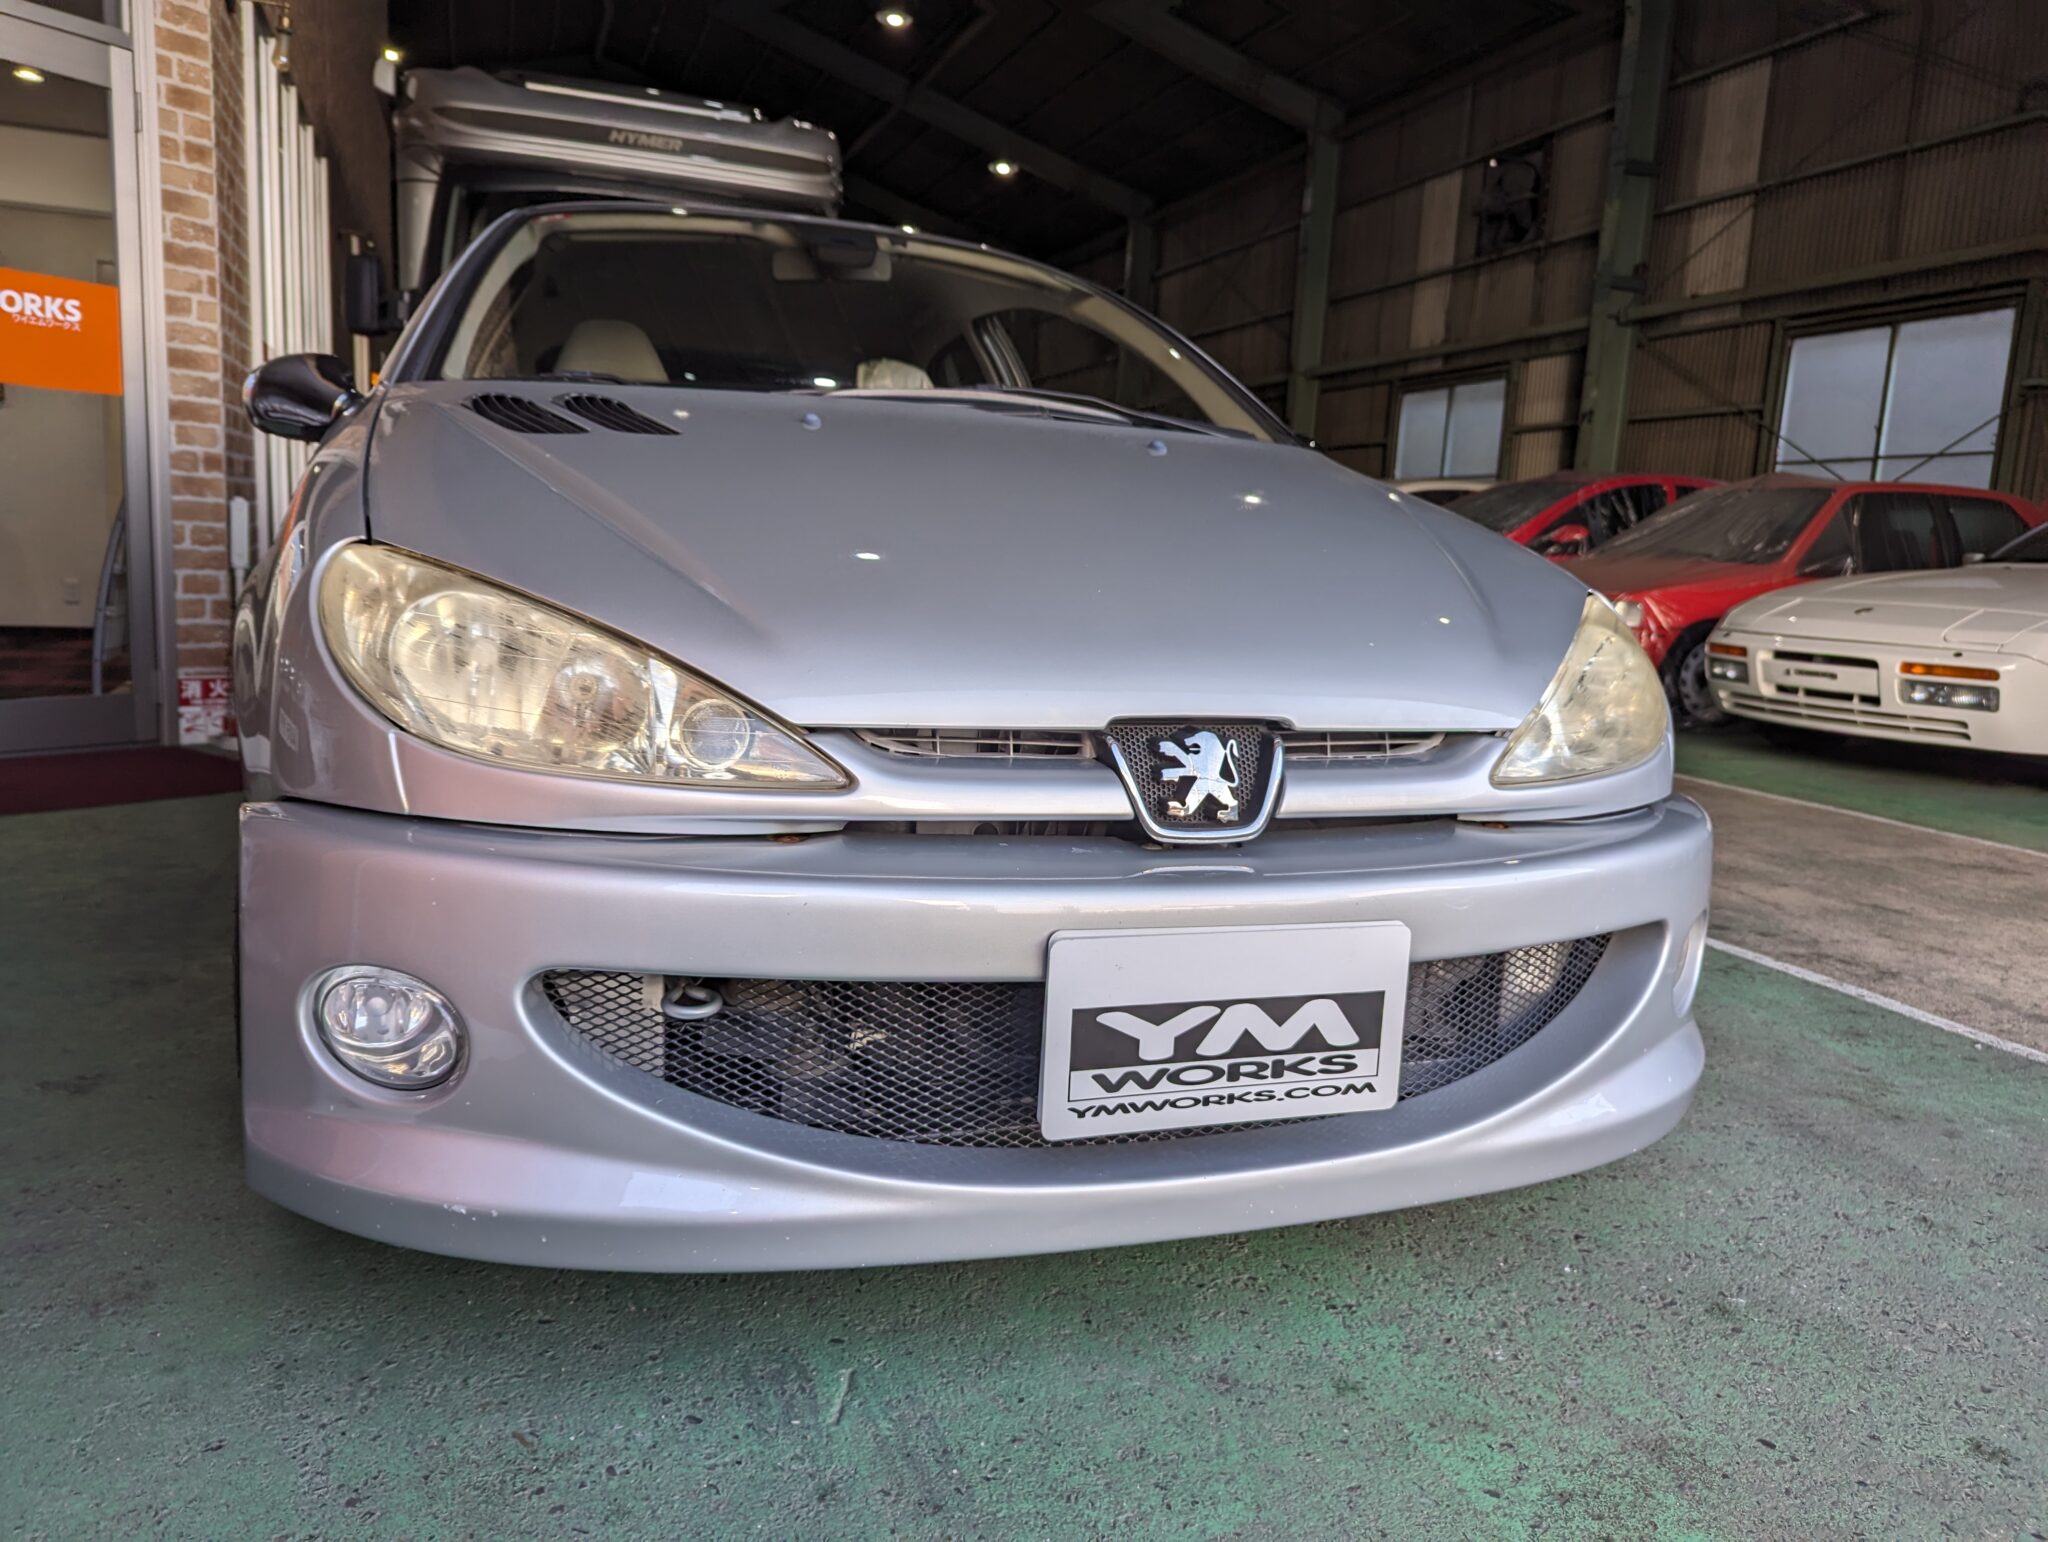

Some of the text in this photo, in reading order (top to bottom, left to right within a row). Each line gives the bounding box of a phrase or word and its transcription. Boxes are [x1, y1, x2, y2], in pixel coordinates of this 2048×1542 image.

[608, 129, 683, 151] HYMER
[1096, 998, 1360, 1061] YM
[1091, 1053, 1359, 1093] WORKS
[1067, 1082, 1377, 1119] YMWORKS.COM
